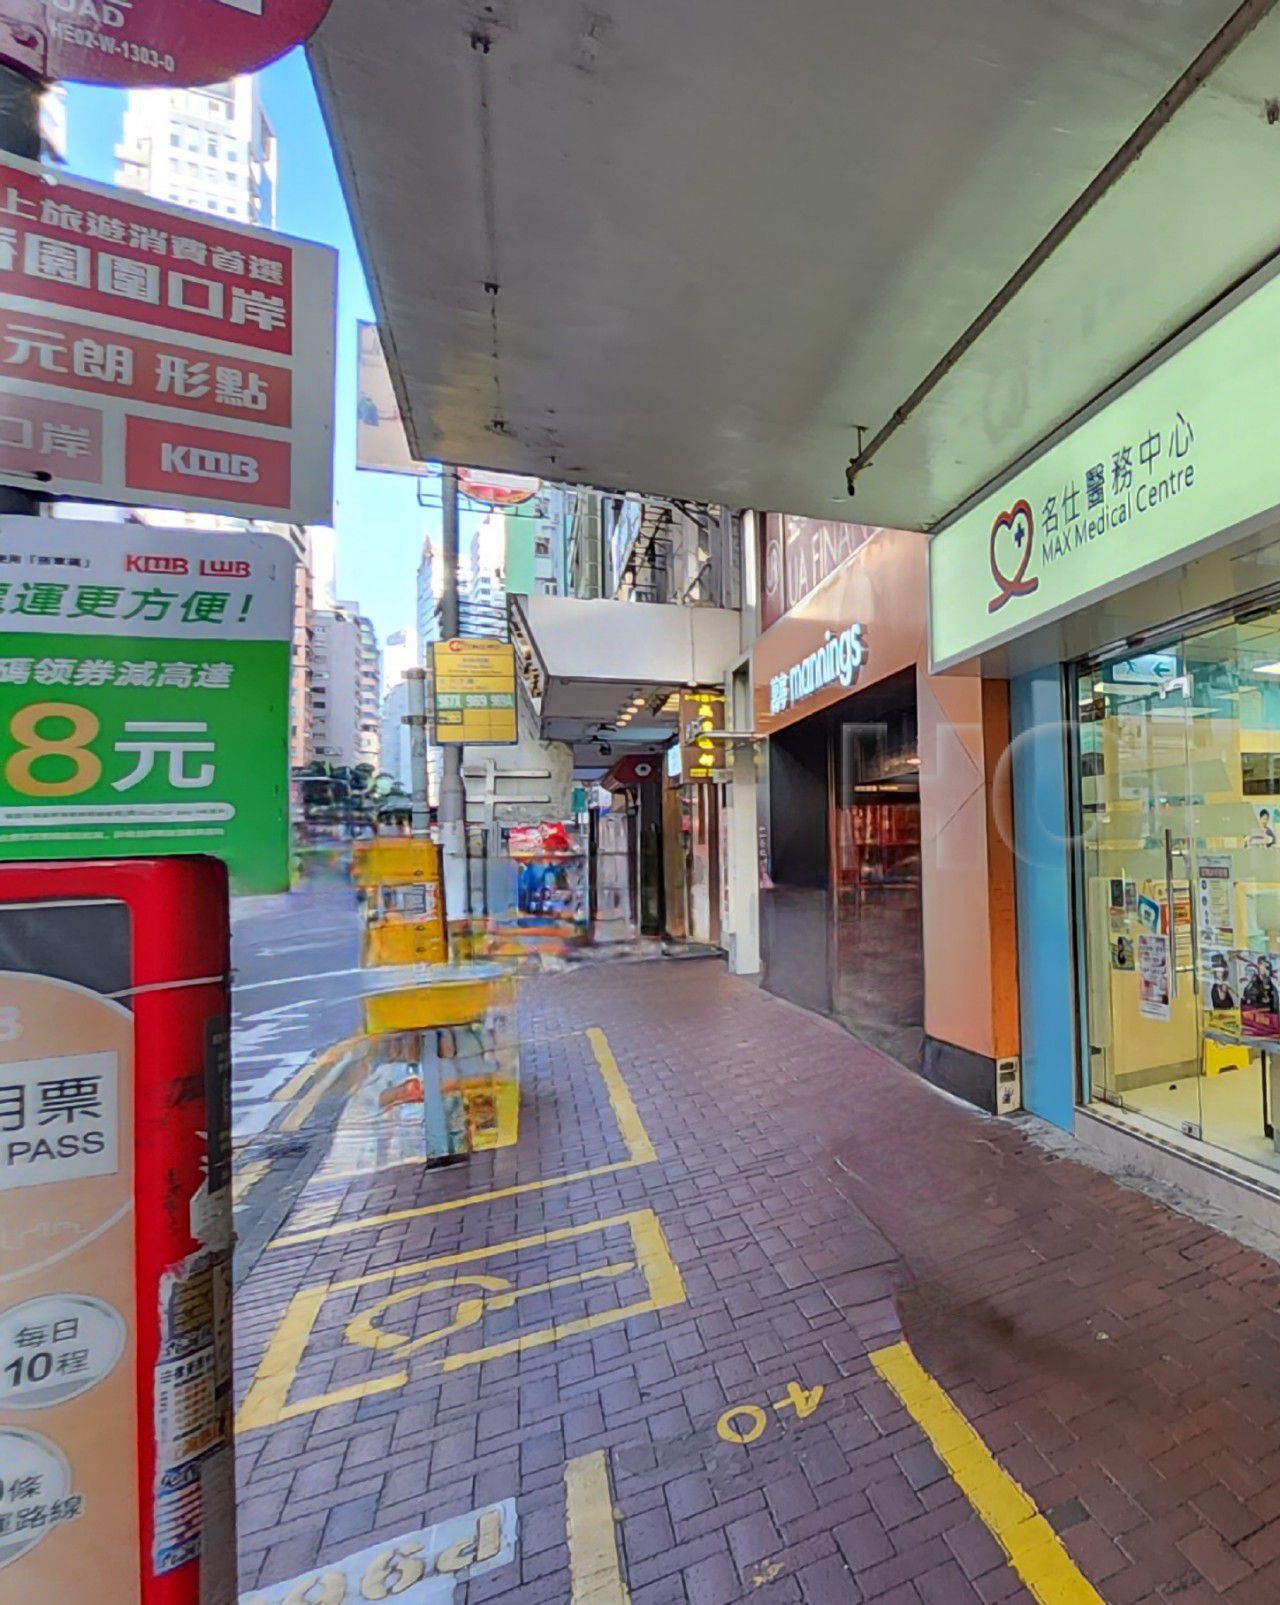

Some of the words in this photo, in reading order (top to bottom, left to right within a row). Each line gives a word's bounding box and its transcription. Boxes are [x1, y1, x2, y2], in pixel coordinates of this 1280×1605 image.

[3, 323, 133, 386] 元朗
[155, 353, 268, 410] 形點
[161, 442, 259, 484] KMB
[1041, 412, 1195, 536] 名仕醫務中心
[1042, 528, 1072, 567] MAX
[1075, 491, 1131, 548] Medical
[1136, 464, 1195, 513] Centre
[125, 554, 189, 576] KMB
[199, 559, 251, 579] LWB
[789, 623, 862, 702] mannings
[7, 1131, 105, 1166] PASS
[14, 1318, 80, 1349] 每日
[3, 1348, 90, 1388] 10程
[0, 1473, 44, 1502] 條
